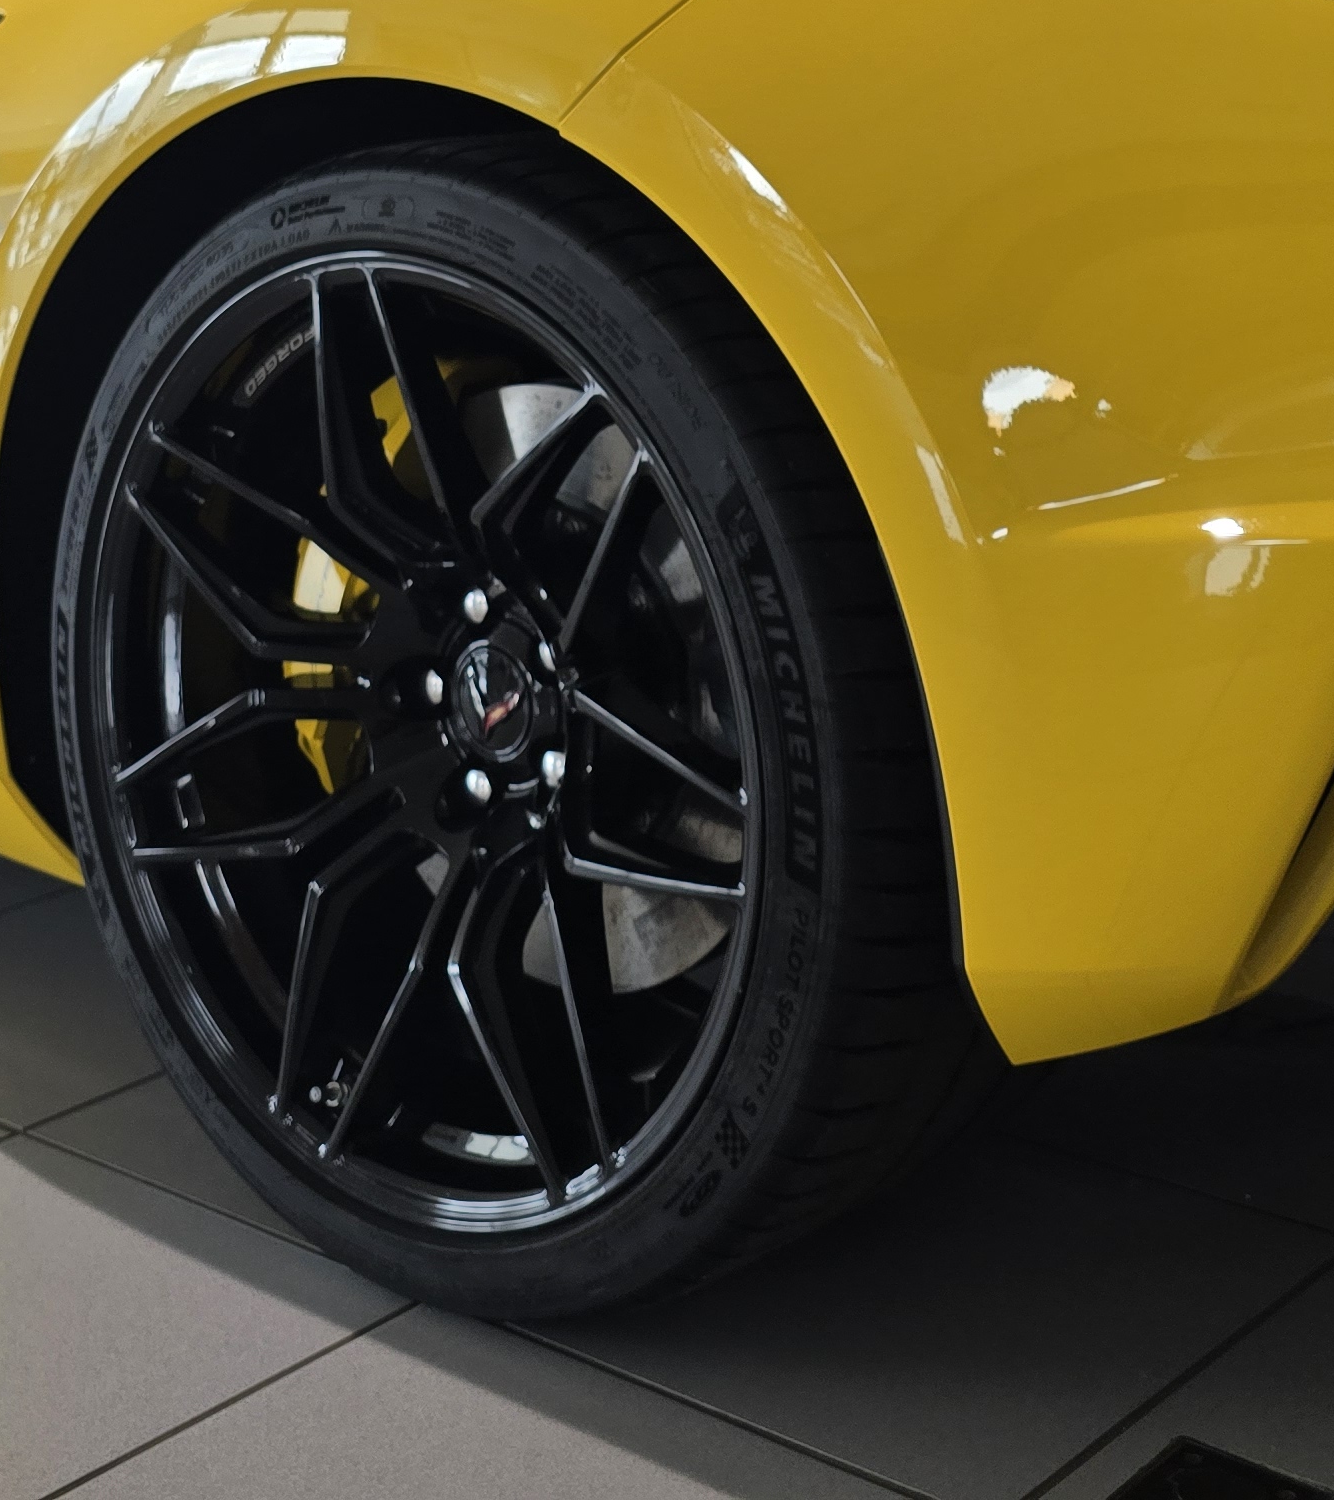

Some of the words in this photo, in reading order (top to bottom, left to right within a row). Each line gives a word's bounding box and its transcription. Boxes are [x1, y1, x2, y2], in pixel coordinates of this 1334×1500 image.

[243, 326, 315, 397] FORGED
[751, 573, 818, 873] MICHELIN
[785, 907, 810, 990] PILOT
[759, 995, 795, 1083] SPORT
